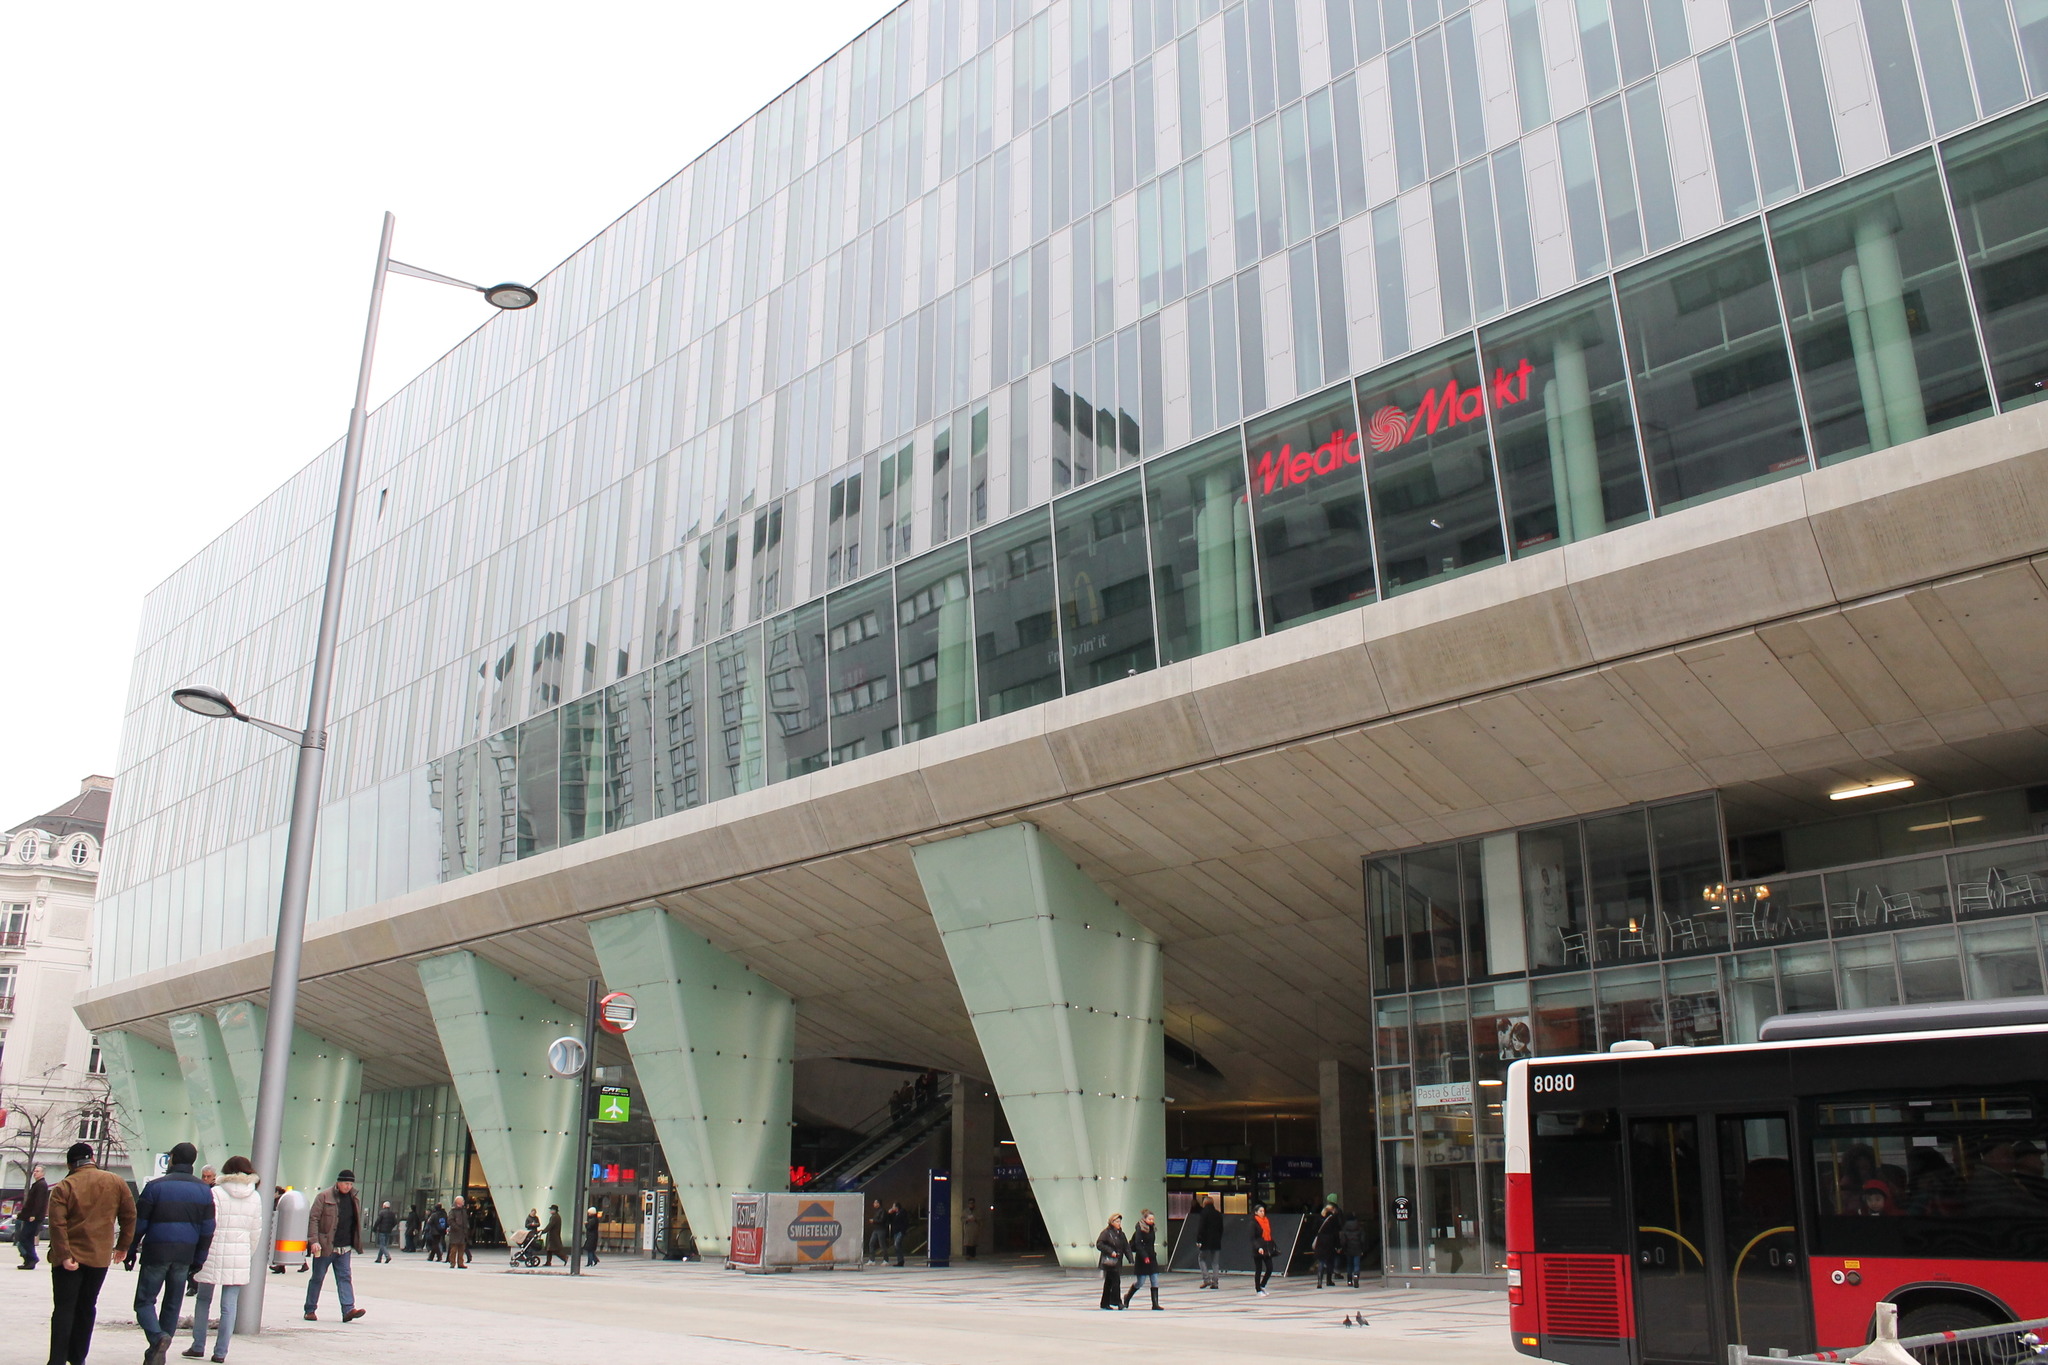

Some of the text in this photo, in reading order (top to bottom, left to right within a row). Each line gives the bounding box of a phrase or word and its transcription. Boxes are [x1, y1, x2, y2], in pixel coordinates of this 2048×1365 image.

[1403, 358, 1534, 444] Makt
[1533, 1073, 1575, 1093] 8080
[1417, 1085, 1470, 1099] Pasta & Café
[789, 1224, 840, 1238] SWIETELSKY
